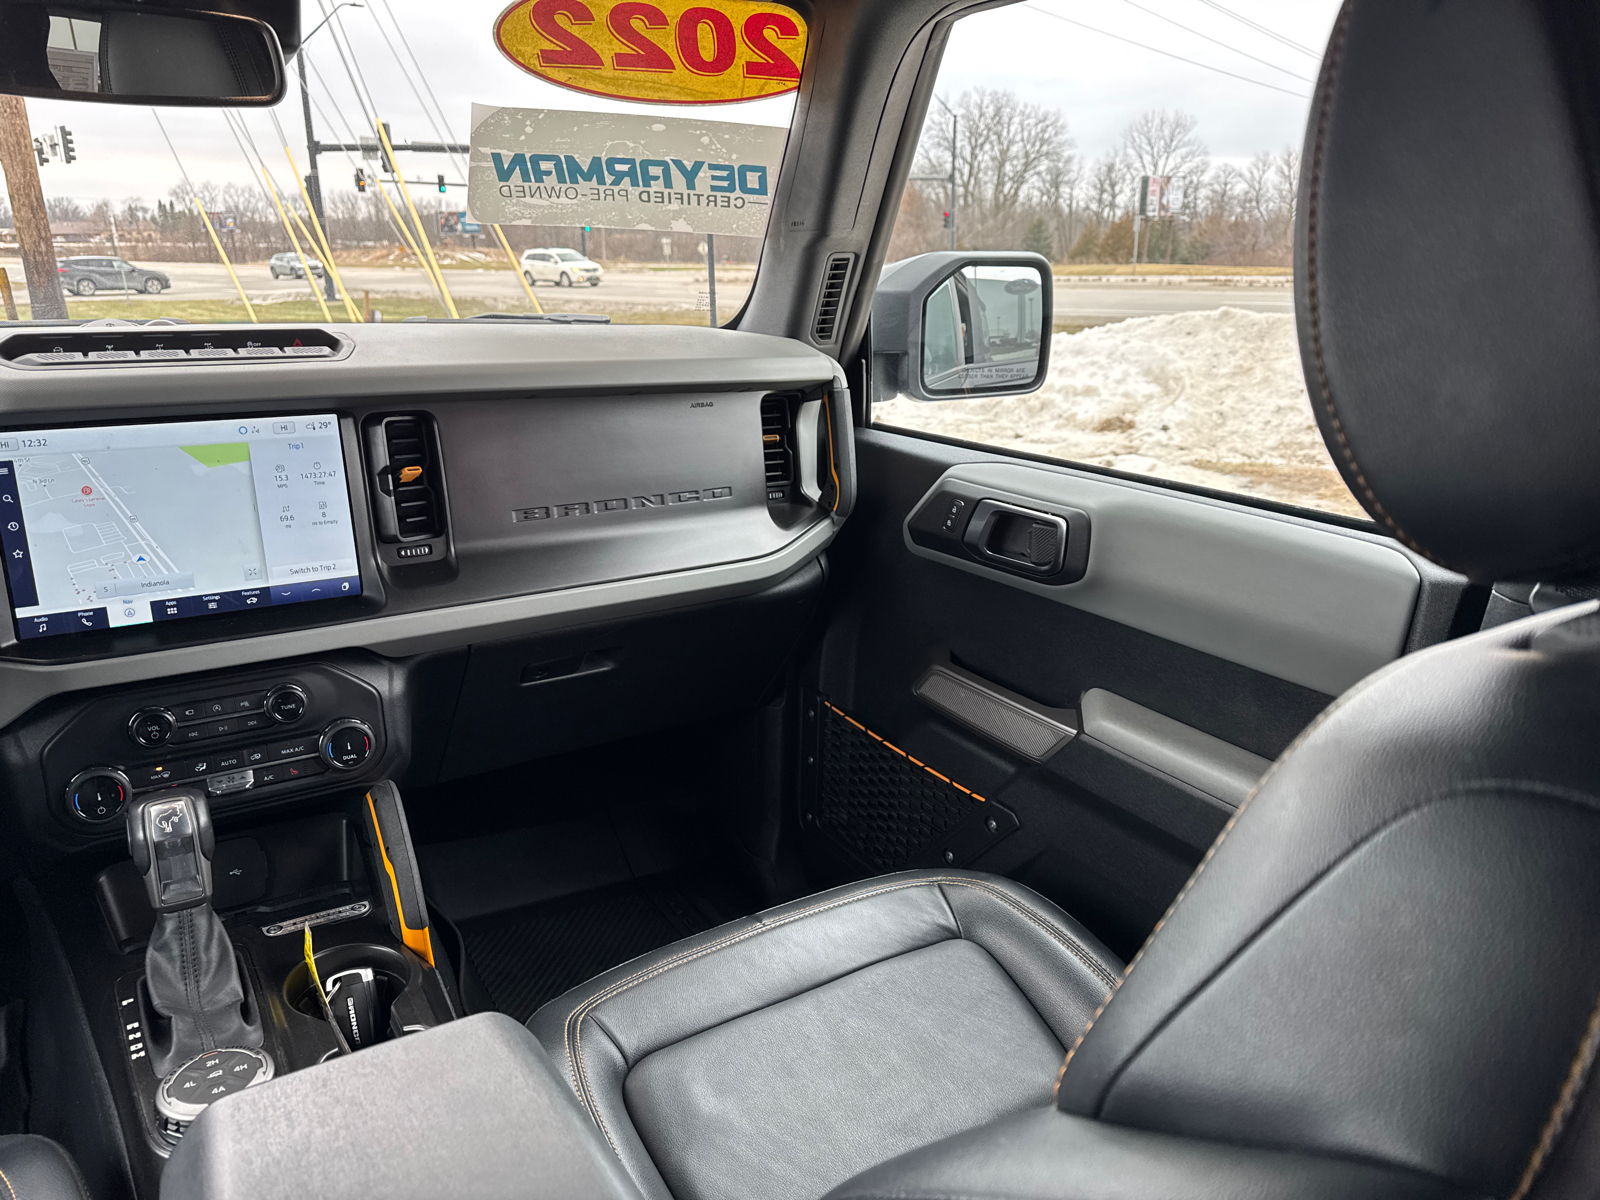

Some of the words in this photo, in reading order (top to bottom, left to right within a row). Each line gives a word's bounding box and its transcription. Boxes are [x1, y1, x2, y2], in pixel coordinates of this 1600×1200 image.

[690, 401, 714, 409] AIRBAG
[280, 424, 288, 432] HI
[318, 421, 332, 429] 29°
[0, 441, 10, 449] HI
[21, 438, 48, 448] 12:32
[274, 474, 289, 482] 15.3
[300, 470, 337, 480] 1473:27:47
[511, 485, 733, 524] BRONCO
[280, 514, 295, 522] 69.6
[289, 567, 311, 575] Switch
[319, 565, 332, 573] Trip
[140, 579, 170, 588] Indianola
[342, 753, 357, 761] DUAL
[220, 758, 237, 767] AUTO
[346, 997, 361, 1046] BRONCO
[205, 1058, 219, 1067] 2H
[233, 1063, 248, 1072] 4H
[183, 1080, 197, 1088] 4L
[211, 1085, 226, 1094] 4A
